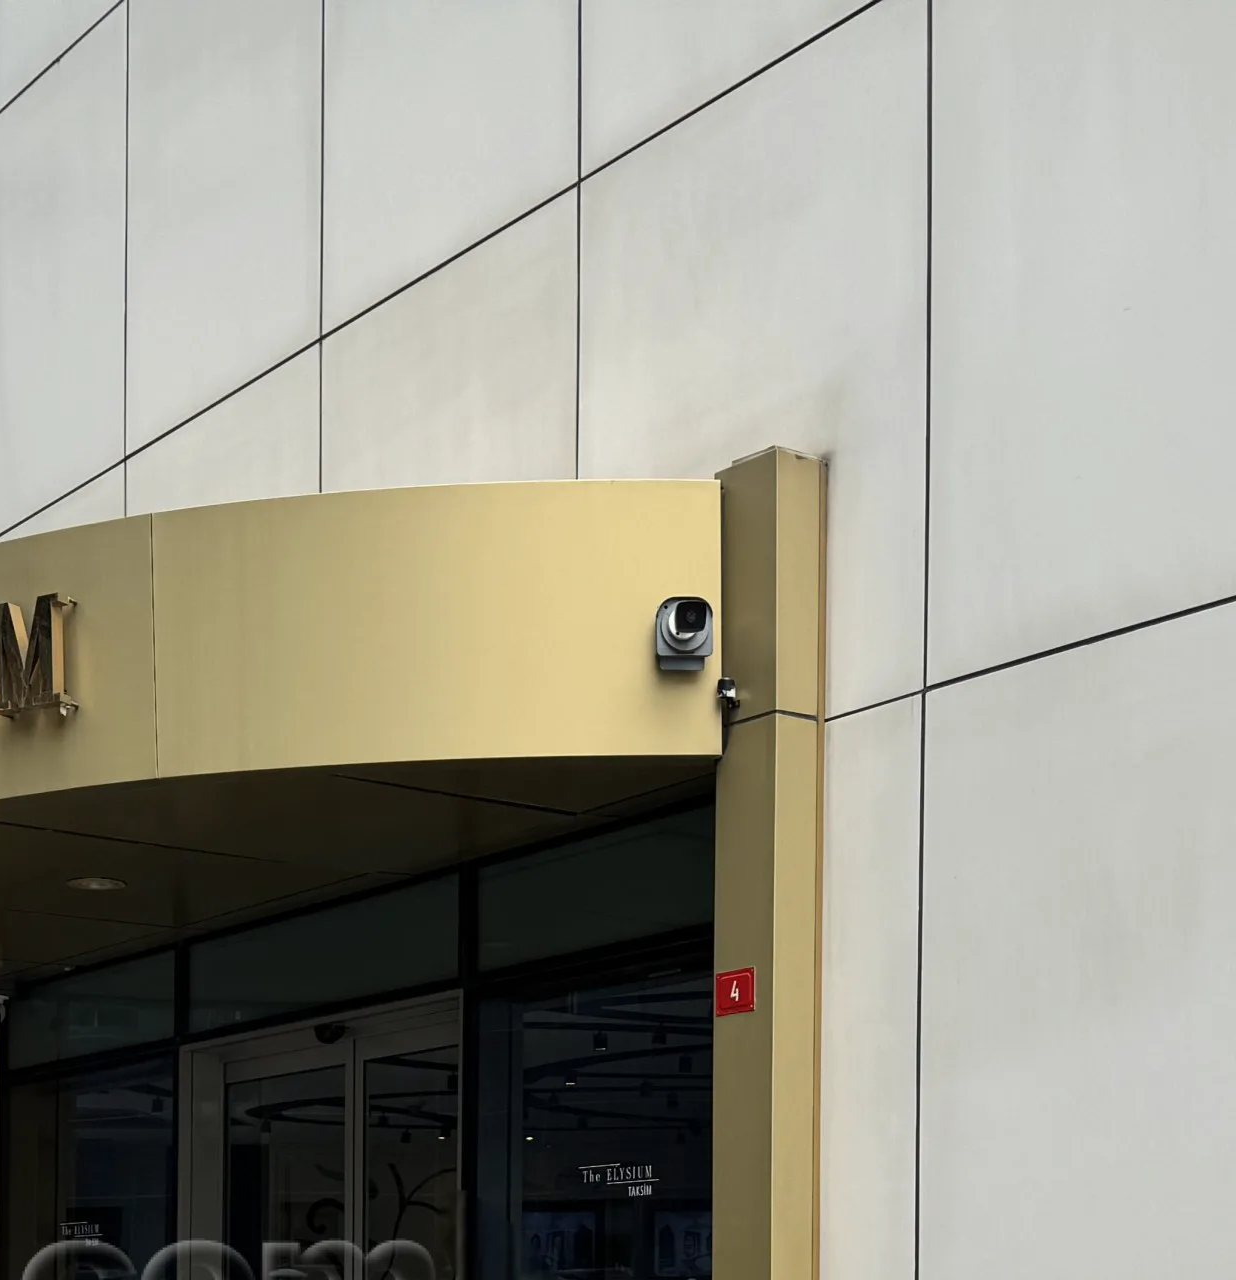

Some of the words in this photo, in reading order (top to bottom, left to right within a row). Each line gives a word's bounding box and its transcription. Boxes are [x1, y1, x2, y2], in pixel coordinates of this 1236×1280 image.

[730, 980, 740, 1002] 4
[583, 1169, 601, 1183] The
[606, 1165, 652, 1181] ELYSIUM
